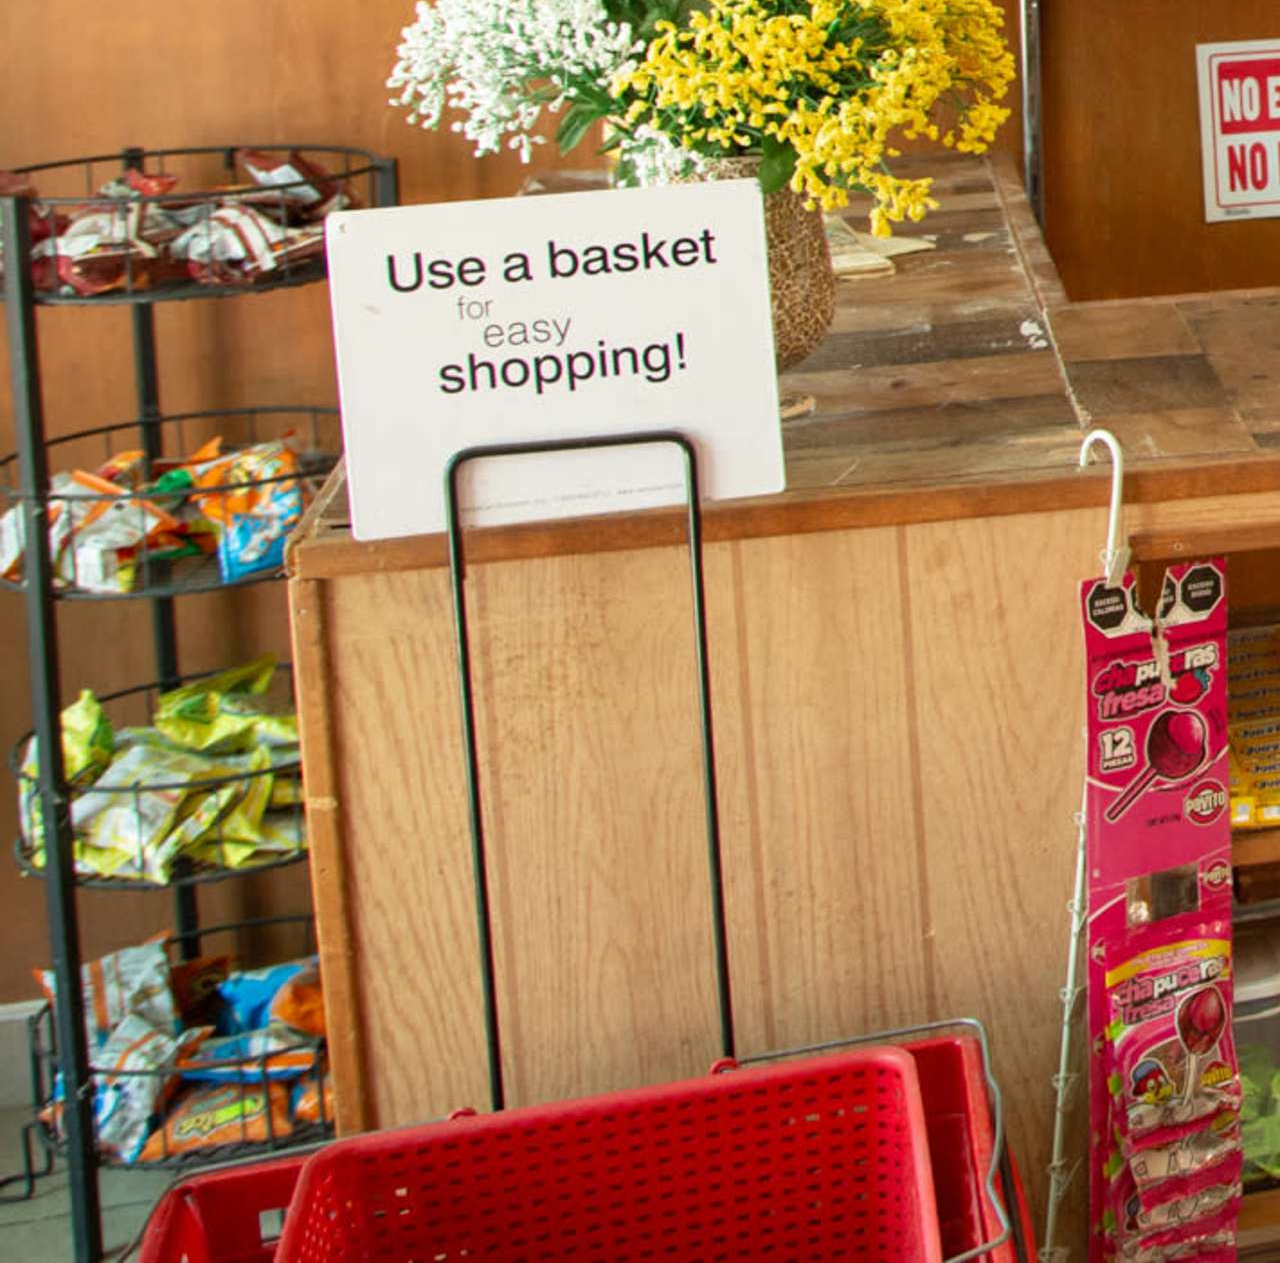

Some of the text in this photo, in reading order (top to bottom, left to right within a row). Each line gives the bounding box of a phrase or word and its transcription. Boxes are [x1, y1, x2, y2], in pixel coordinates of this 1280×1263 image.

[1220, 76, 1262, 123] NO
[1226, 142, 1269, 193] NO
[387, 228, 718, 294] Use a basket
[456, 294, 494, 322] for
[483, 315, 572, 349] easy
[438, 332, 688, 396] shopping!
[1102, 684, 1165, 719] fresa
[1101, 729, 1133, 760] 12
